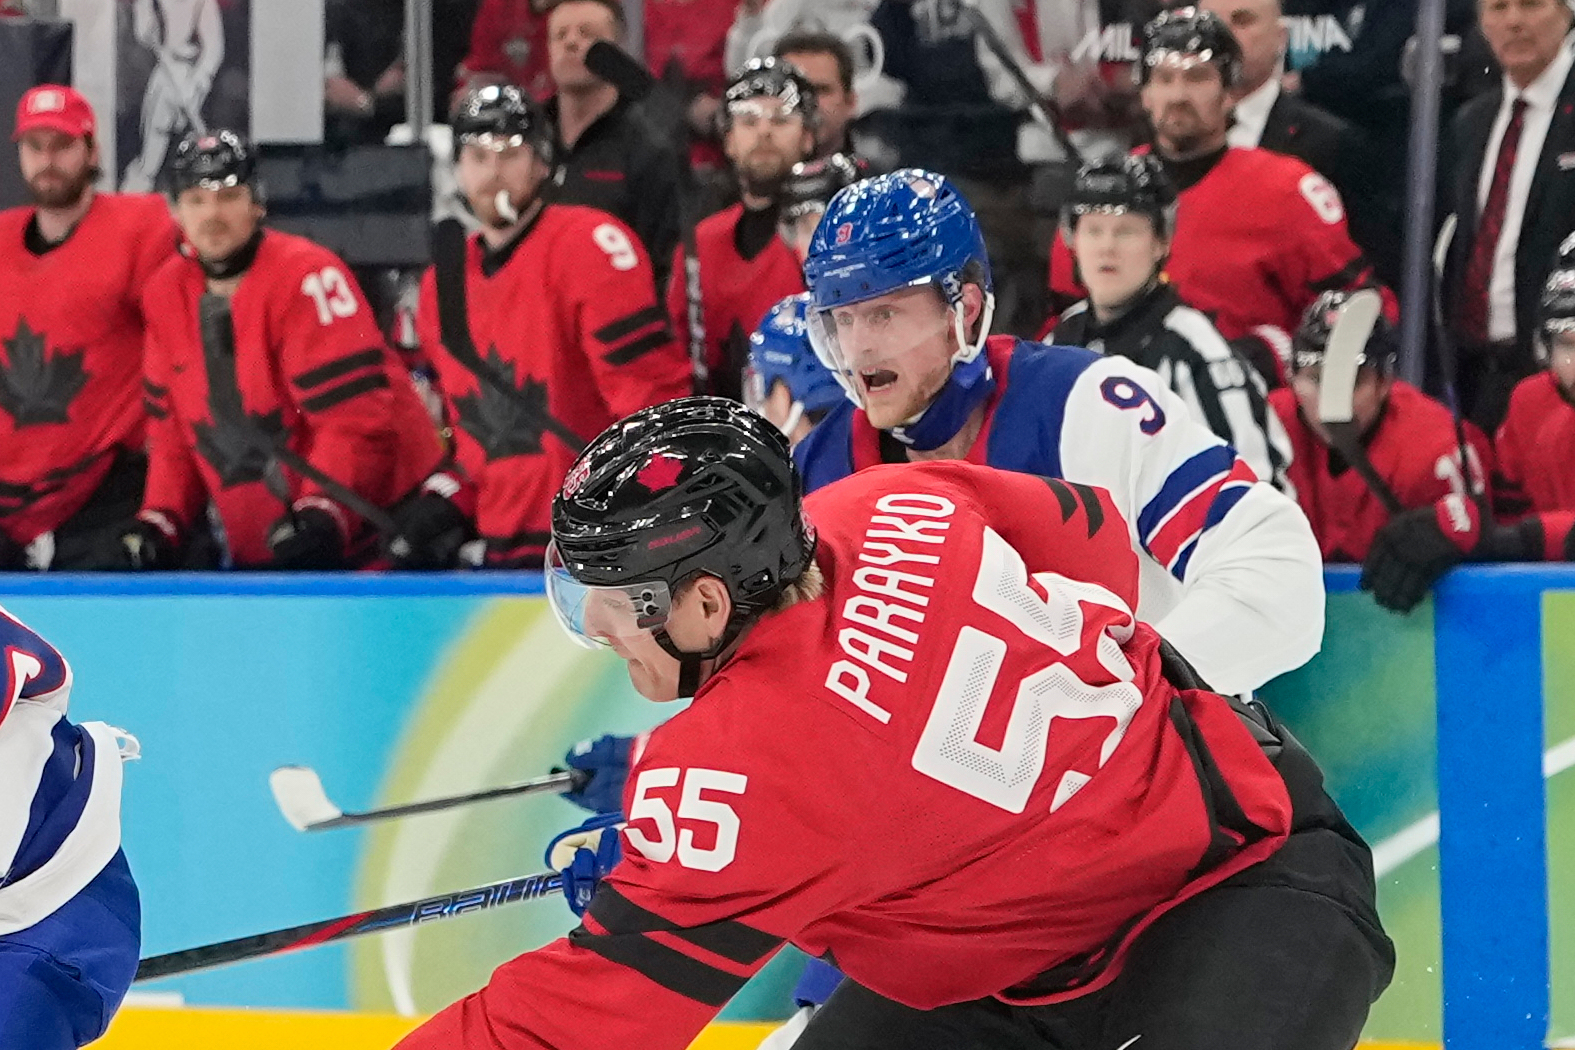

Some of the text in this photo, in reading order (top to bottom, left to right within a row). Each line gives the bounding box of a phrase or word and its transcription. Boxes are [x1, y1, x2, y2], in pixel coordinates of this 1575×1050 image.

[592, 223, 639, 271] 9
[300, 265, 359, 326] 13
[1099, 376, 1167, 437] 9
[824, 493, 956, 725] PARAYKO
[911, 525, 1144, 815] 55
[624, 767, 749, 873] 55
